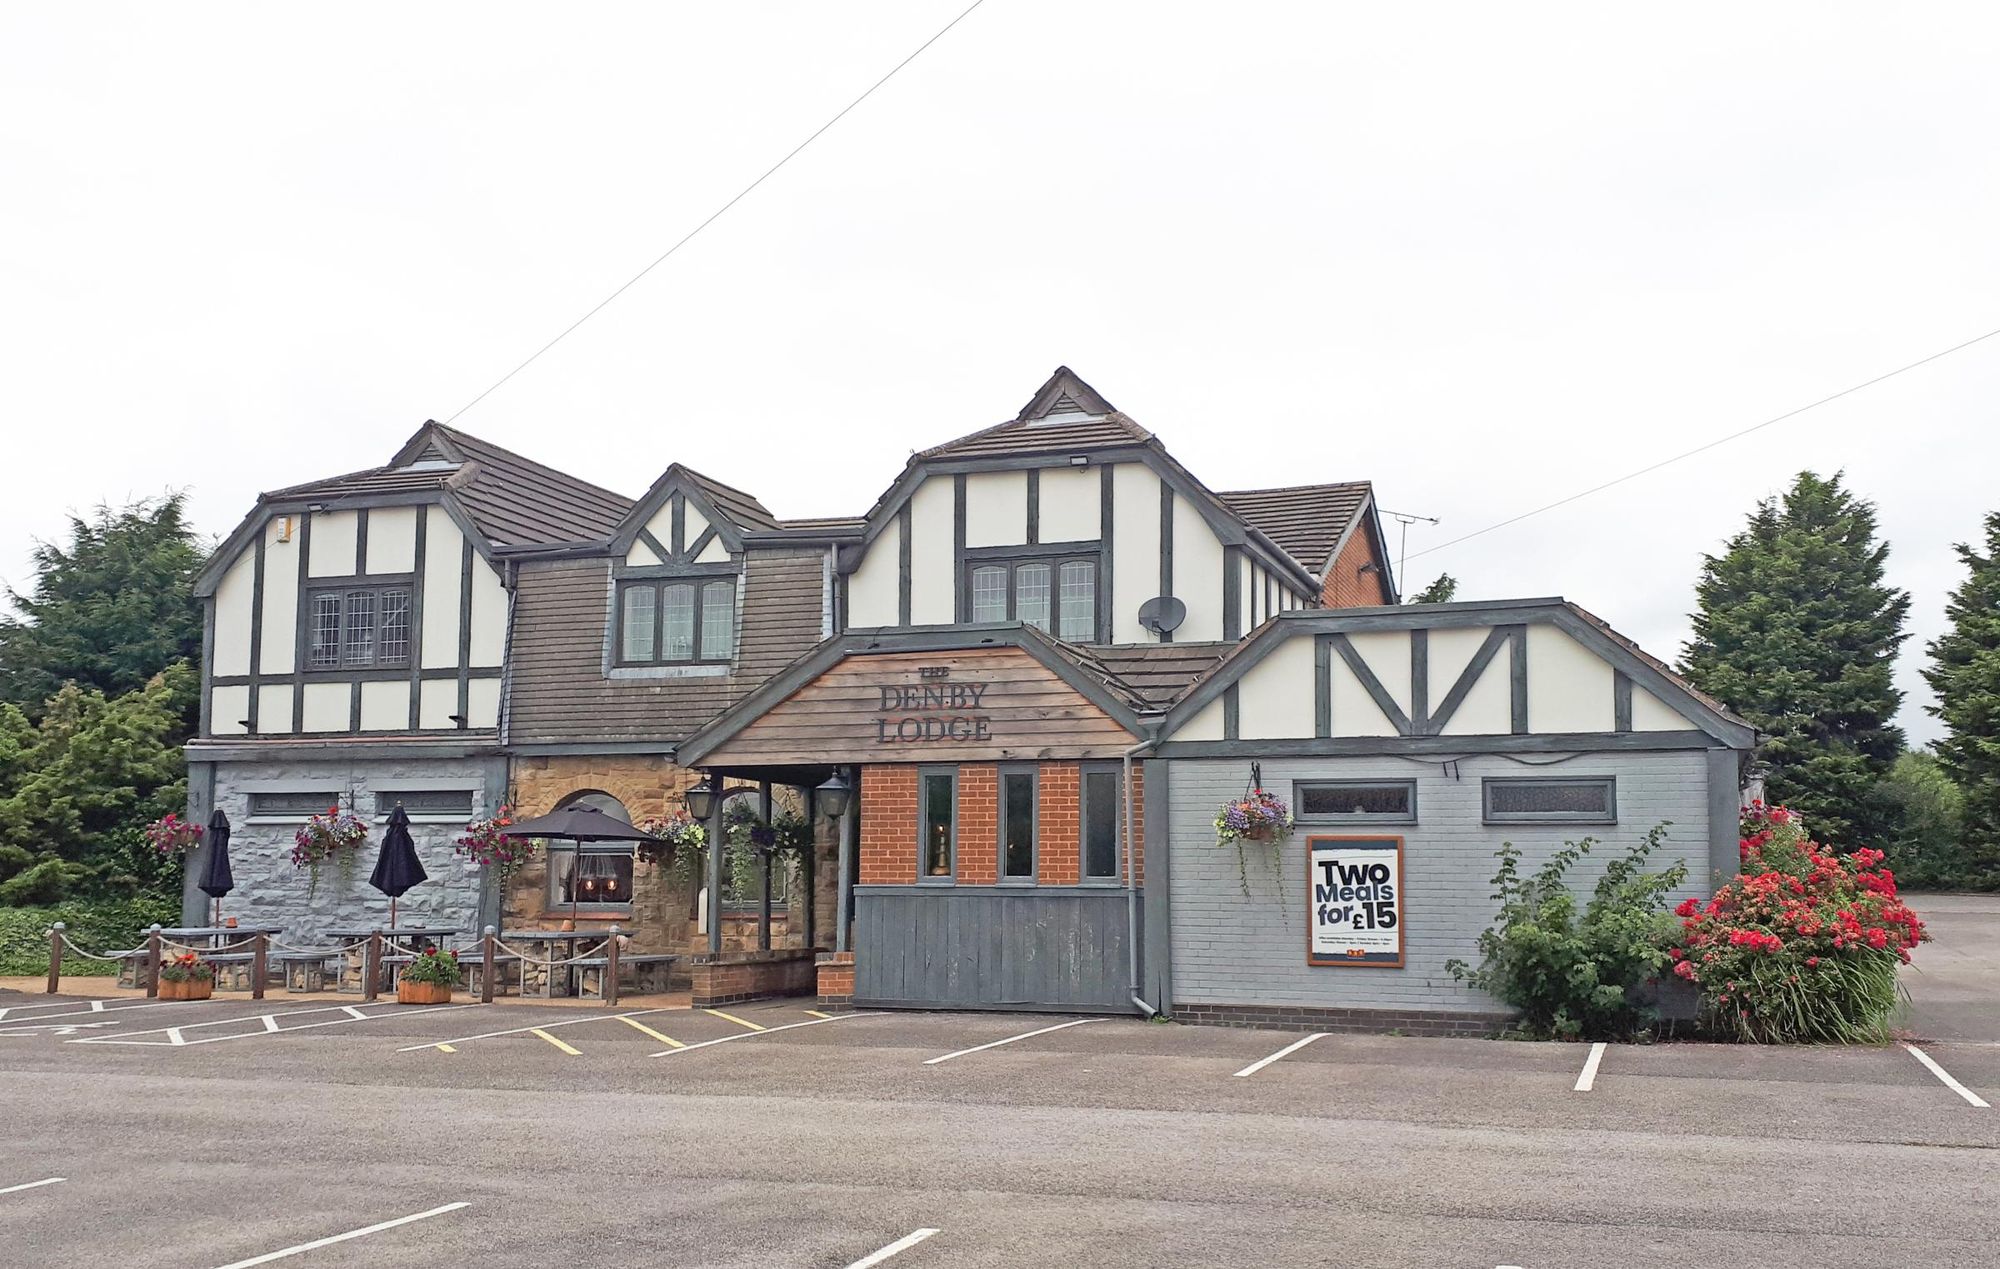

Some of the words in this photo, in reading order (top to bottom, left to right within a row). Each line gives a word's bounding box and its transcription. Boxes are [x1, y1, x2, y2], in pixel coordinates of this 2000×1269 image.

[918, 666, 950, 678] THE
[879, 684, 988, 712] DENBY
[876, 717, 992, 743] LODGE
[1318, 860, 1390, 886] Two
[1316, 881, 1394, 903] Meals
[1318, 904, 1354, 926] for
[1352, 901, 1397, 929] £15
